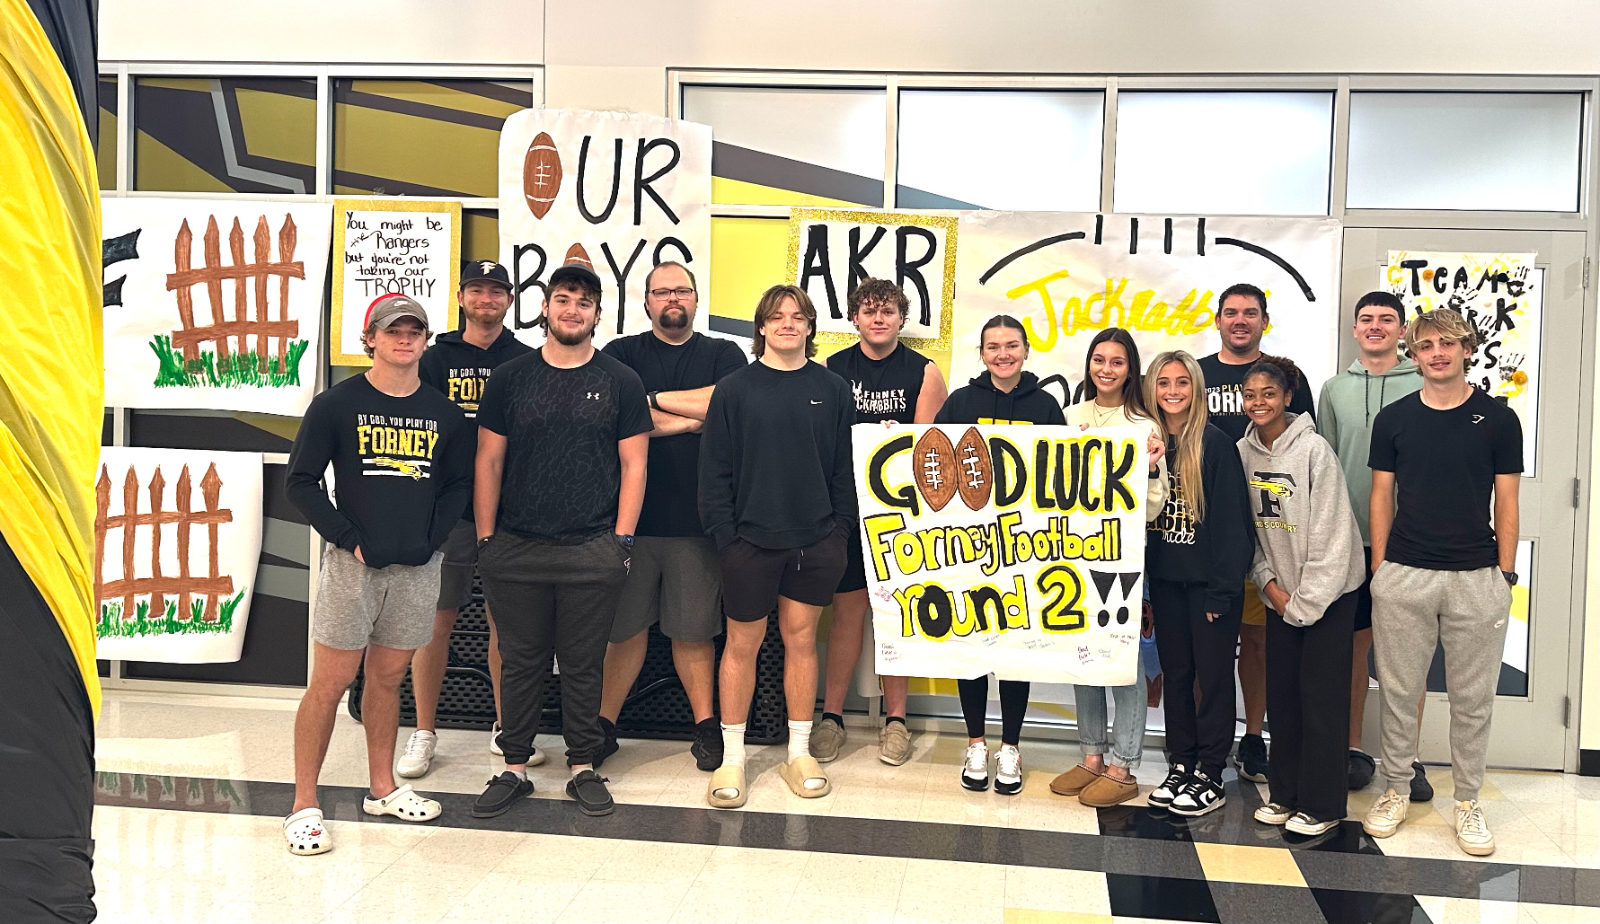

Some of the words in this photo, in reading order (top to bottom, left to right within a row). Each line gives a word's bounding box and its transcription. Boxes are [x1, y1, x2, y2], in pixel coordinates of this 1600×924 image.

[346, 211, 369, 230] You
[380, 219, 414, 235] might
[426, 216, 443, 231] be
[374, 230, 430, 255] Rangers
[345, 251, 364, 264] but
[371, 252, 406, 267] you're
[409, 253, 430, 264] not
[356, 264, 396, 280] taking
[404, 267, 430, 276] our
[354, 276, 436, 298] TROPHY
[449, 368, 458, 378] BY
[478, 367, 491, 377] YOU
[1207, 391, 1246, 414] ORN
[357, 413, 368, 426] BY
[389, 416, 403, 427] YOU
[405, 417, 423, 428] PLAY
[425, 419, 438, 432] FOR
[356, 424, 439, 460] FORNEY
[1034, 437, 1137, 512] LUCK
[863, 512, 1001, 582] Forney
[997, 511, 1121, 567] Football
[892, 574, 1031, 640] round
